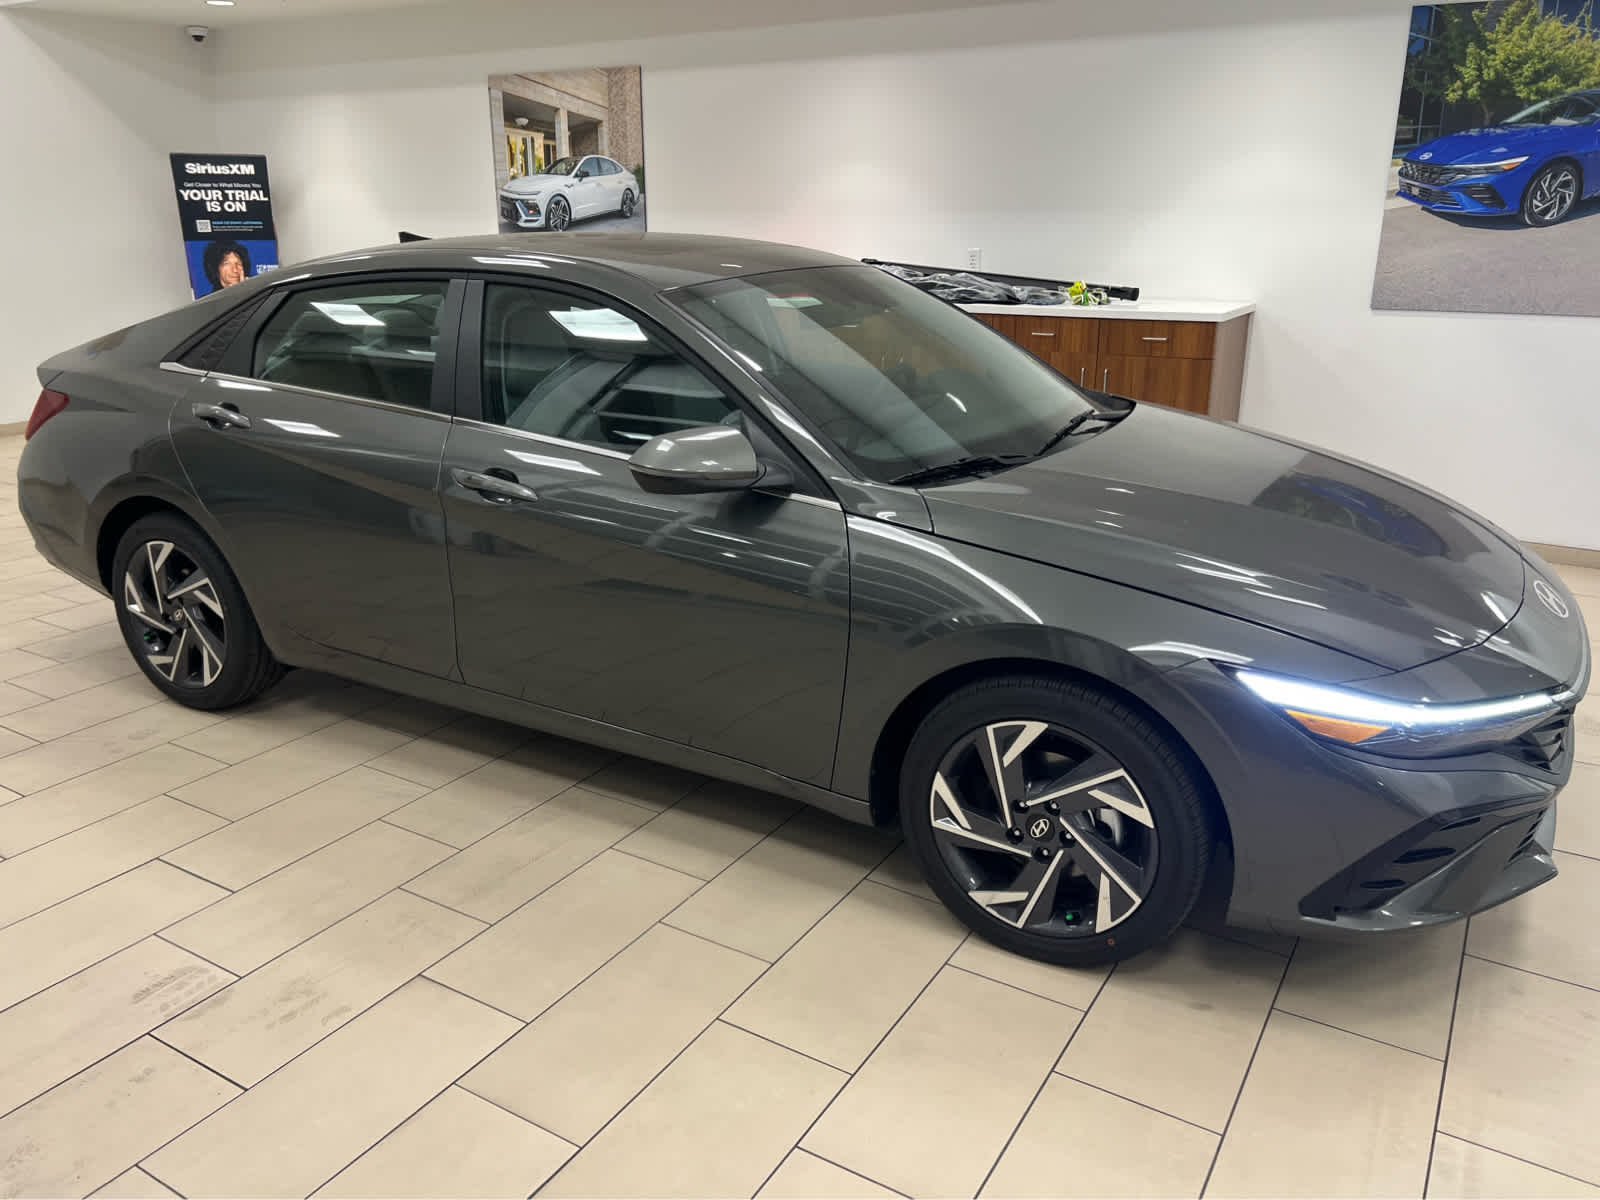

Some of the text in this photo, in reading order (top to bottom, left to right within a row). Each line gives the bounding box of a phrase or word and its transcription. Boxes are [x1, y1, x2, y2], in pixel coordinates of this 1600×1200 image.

[185, 163, 255, 175] SiriusXM
[180, 189, 268, 201] YOUR TRIAL
[206, 201, 247, 212] IS ON
